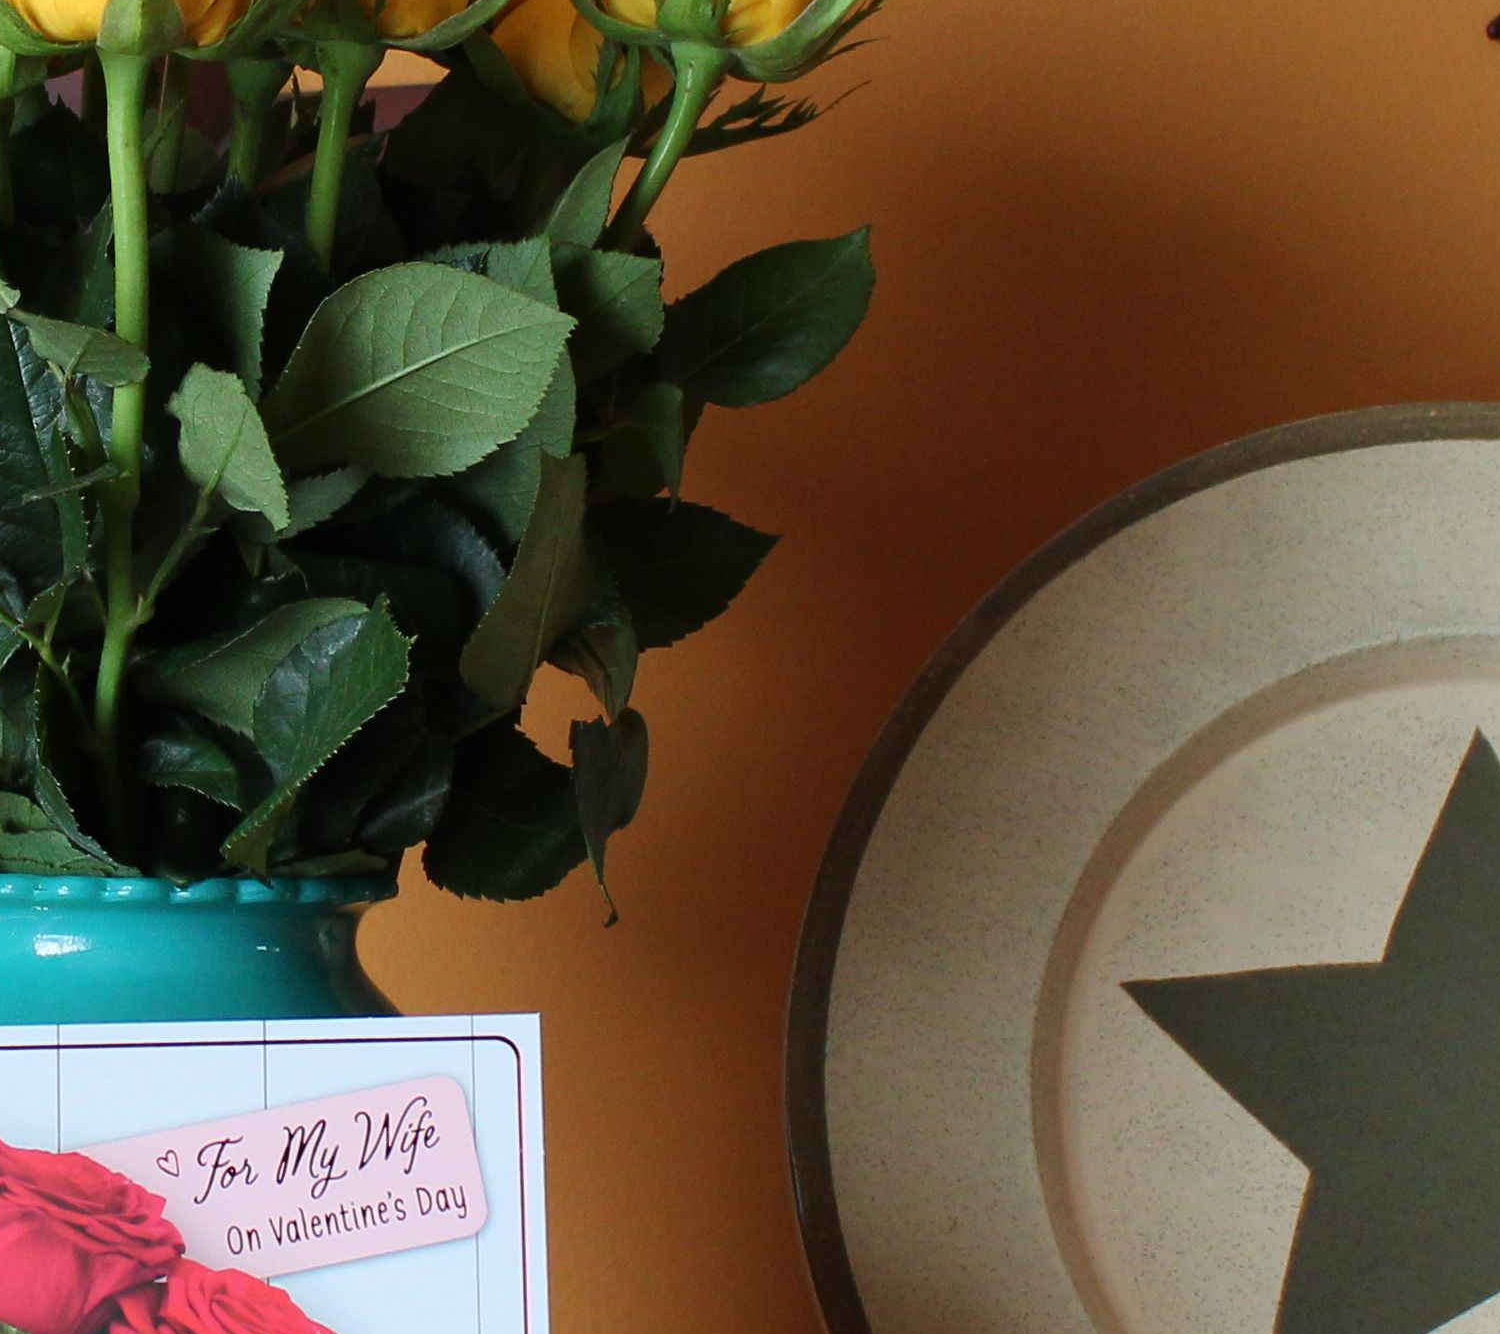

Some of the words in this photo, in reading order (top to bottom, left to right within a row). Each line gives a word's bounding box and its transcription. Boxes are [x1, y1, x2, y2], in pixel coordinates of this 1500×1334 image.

[194, 1136, 259, 1204] For
[276, 1119, 347, 1199] My
[354, 1096, 440, 1175] Wife
[227, 1226, 262, 1255] On
[269, 1191, 407, 1246] Valentine's
[415, 1185, 468, 1219] Day
